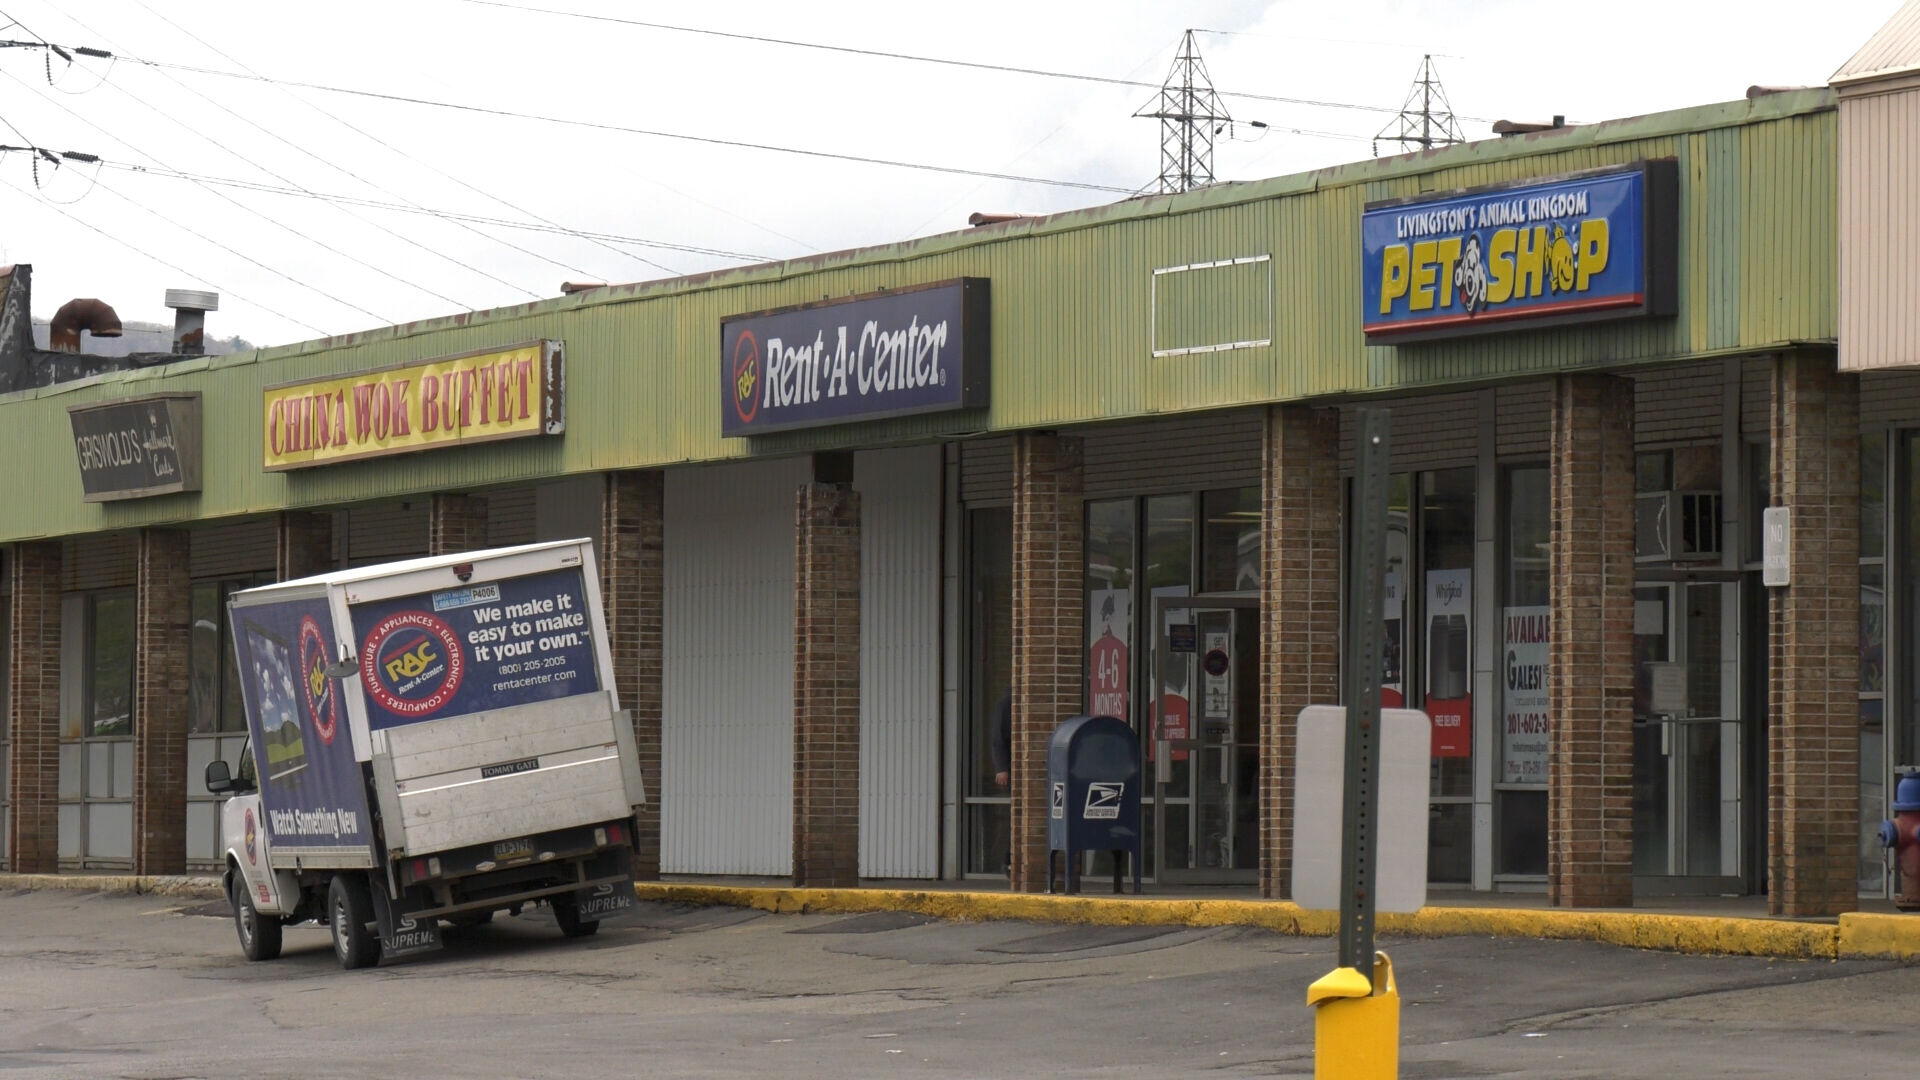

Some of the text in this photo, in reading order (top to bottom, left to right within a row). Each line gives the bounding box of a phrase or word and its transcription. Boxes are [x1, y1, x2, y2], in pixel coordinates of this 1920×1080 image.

[1397, 190, 1588, 238] LIVINGSTON'S ANIMAL KINGDOM
[1380, 237, 1462, 315] PET
[269, 355, 534, 457] CHINA WOK BUFFET
[77, 429, 141, 471] GRISWOLD'S
[143, 424, 175, 464] Hallmark
[153, 454, 174, 477] Cards
[1770, 524, 1783, 542] NO
[472, 587, 496, 600] P4006
[473, 593, 572, 624] We make it
[379, 615, 433, 636] APPLIANCES
[468, 613, 583, 644] easy to make
[385, 641, 437, 682] RAC
[440, 629, 460, 689] ELECTRONICS
[475, 646, 490, 662] it
[493, 639, 534, 662] your
[365, 642, 382, 694] FURNITURE
[499, 656, 566, 675] (800) 205-2005
[1098, 649, 1119, 689] 4-6
[493, 669, 577, 692] rentacentercom
[386, 695, 442, 712] COMPUTERS
[1095, 692, 1122, 715] MONTHS
[1507, 713, 1550, 735] 201-602-3
[482, 759, 538, 777] TOMMY GATE
[270, 807, 358, 839] Watch Something New
[580, 896, 631, 914] SUPREME
[384, 931, 435, 949] SUPREME
